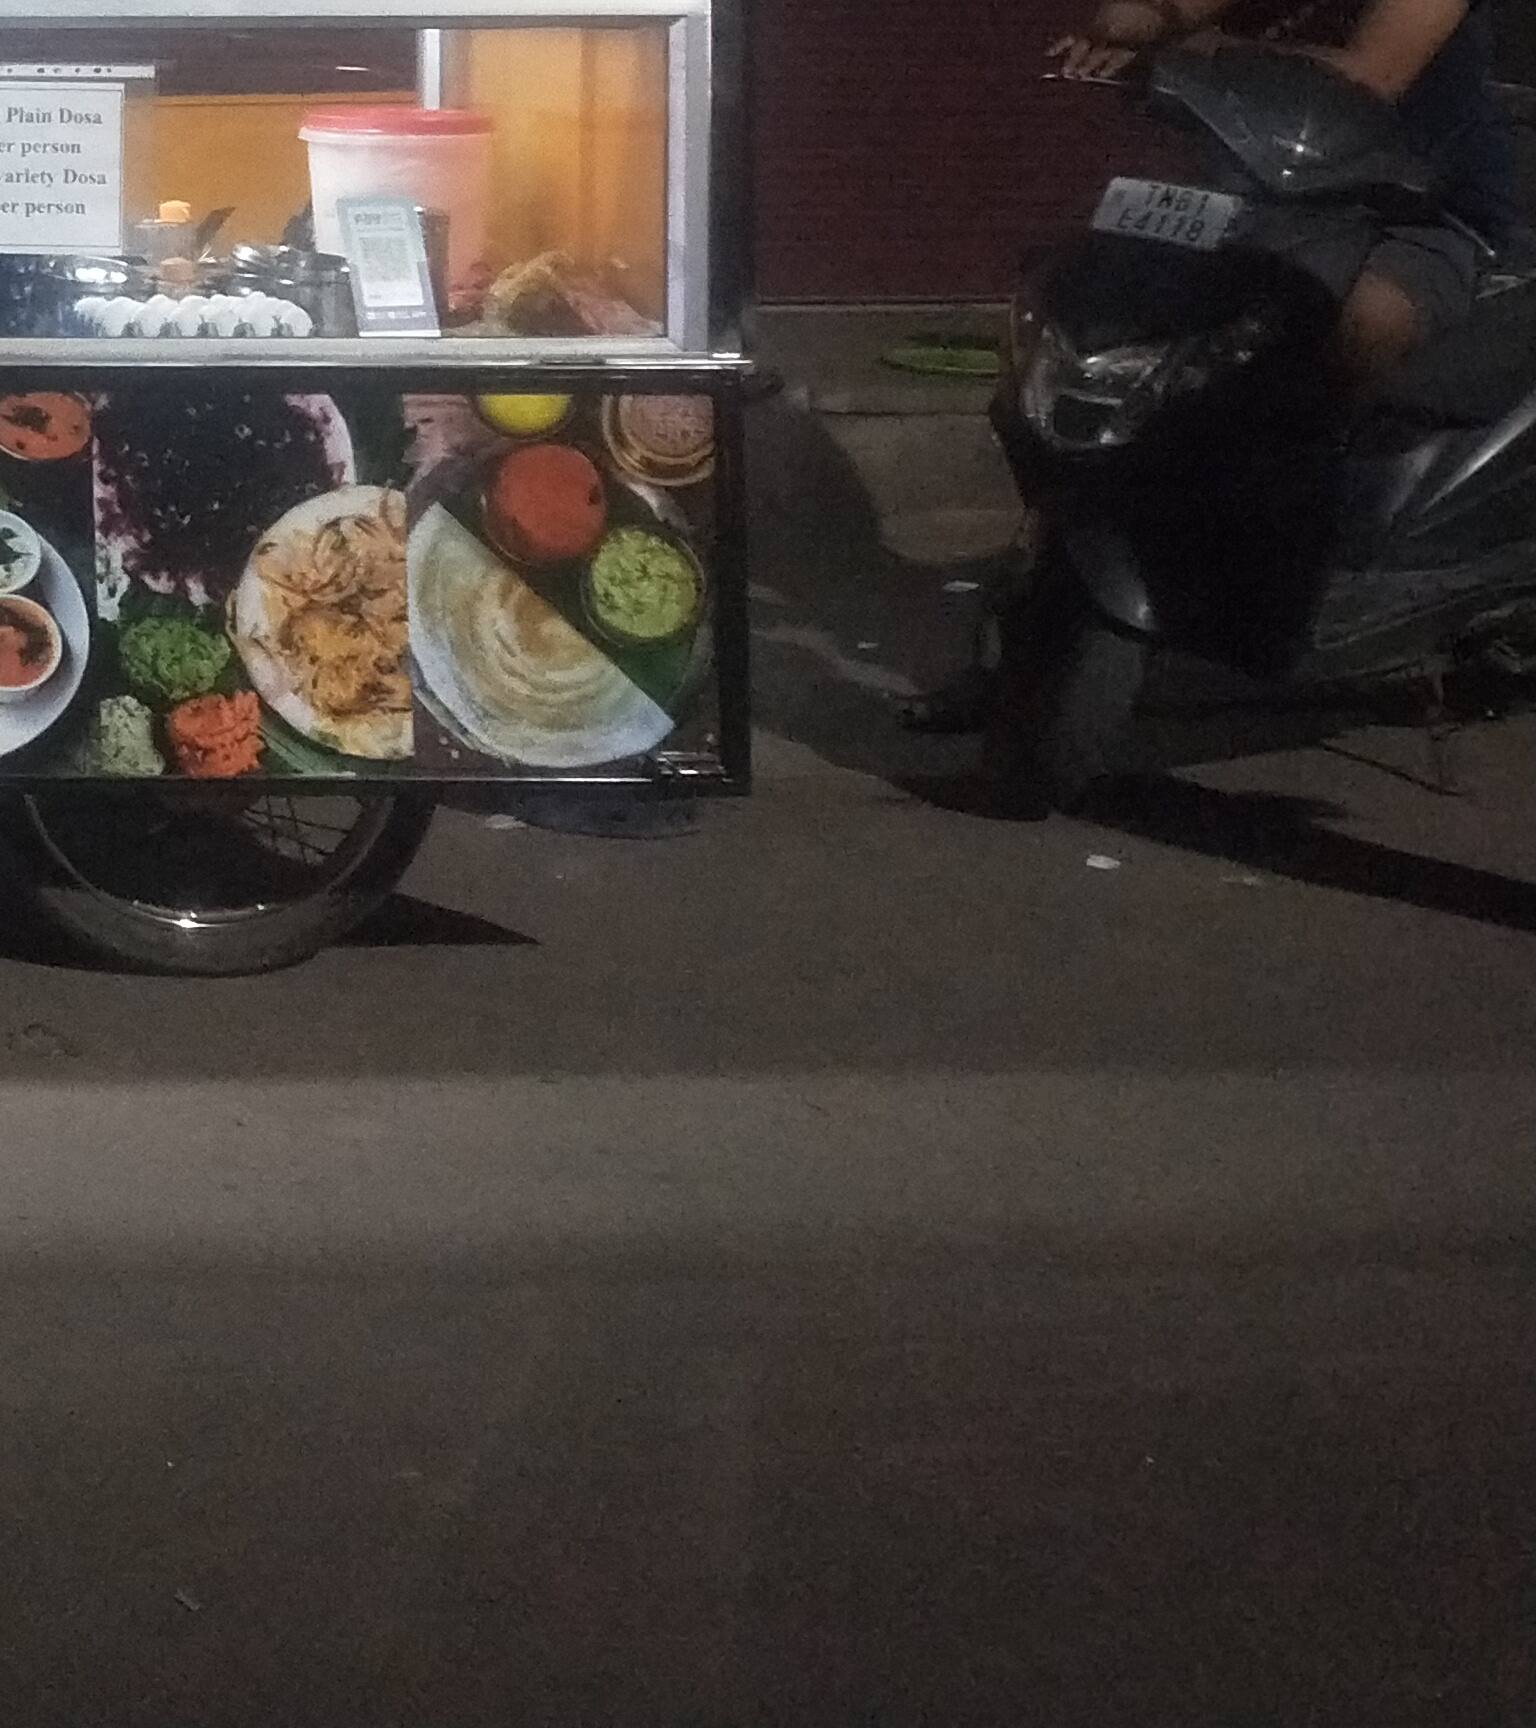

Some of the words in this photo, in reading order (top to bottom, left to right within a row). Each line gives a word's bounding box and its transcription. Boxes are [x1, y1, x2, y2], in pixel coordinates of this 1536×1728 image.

[7, 106, 53, 125] Plain
[58, 107, 103, 125] Dosa
[20, 140, 82, 158] person
[62, 168, 108, 186] Dosa
[24, 201, 87, 217] person
